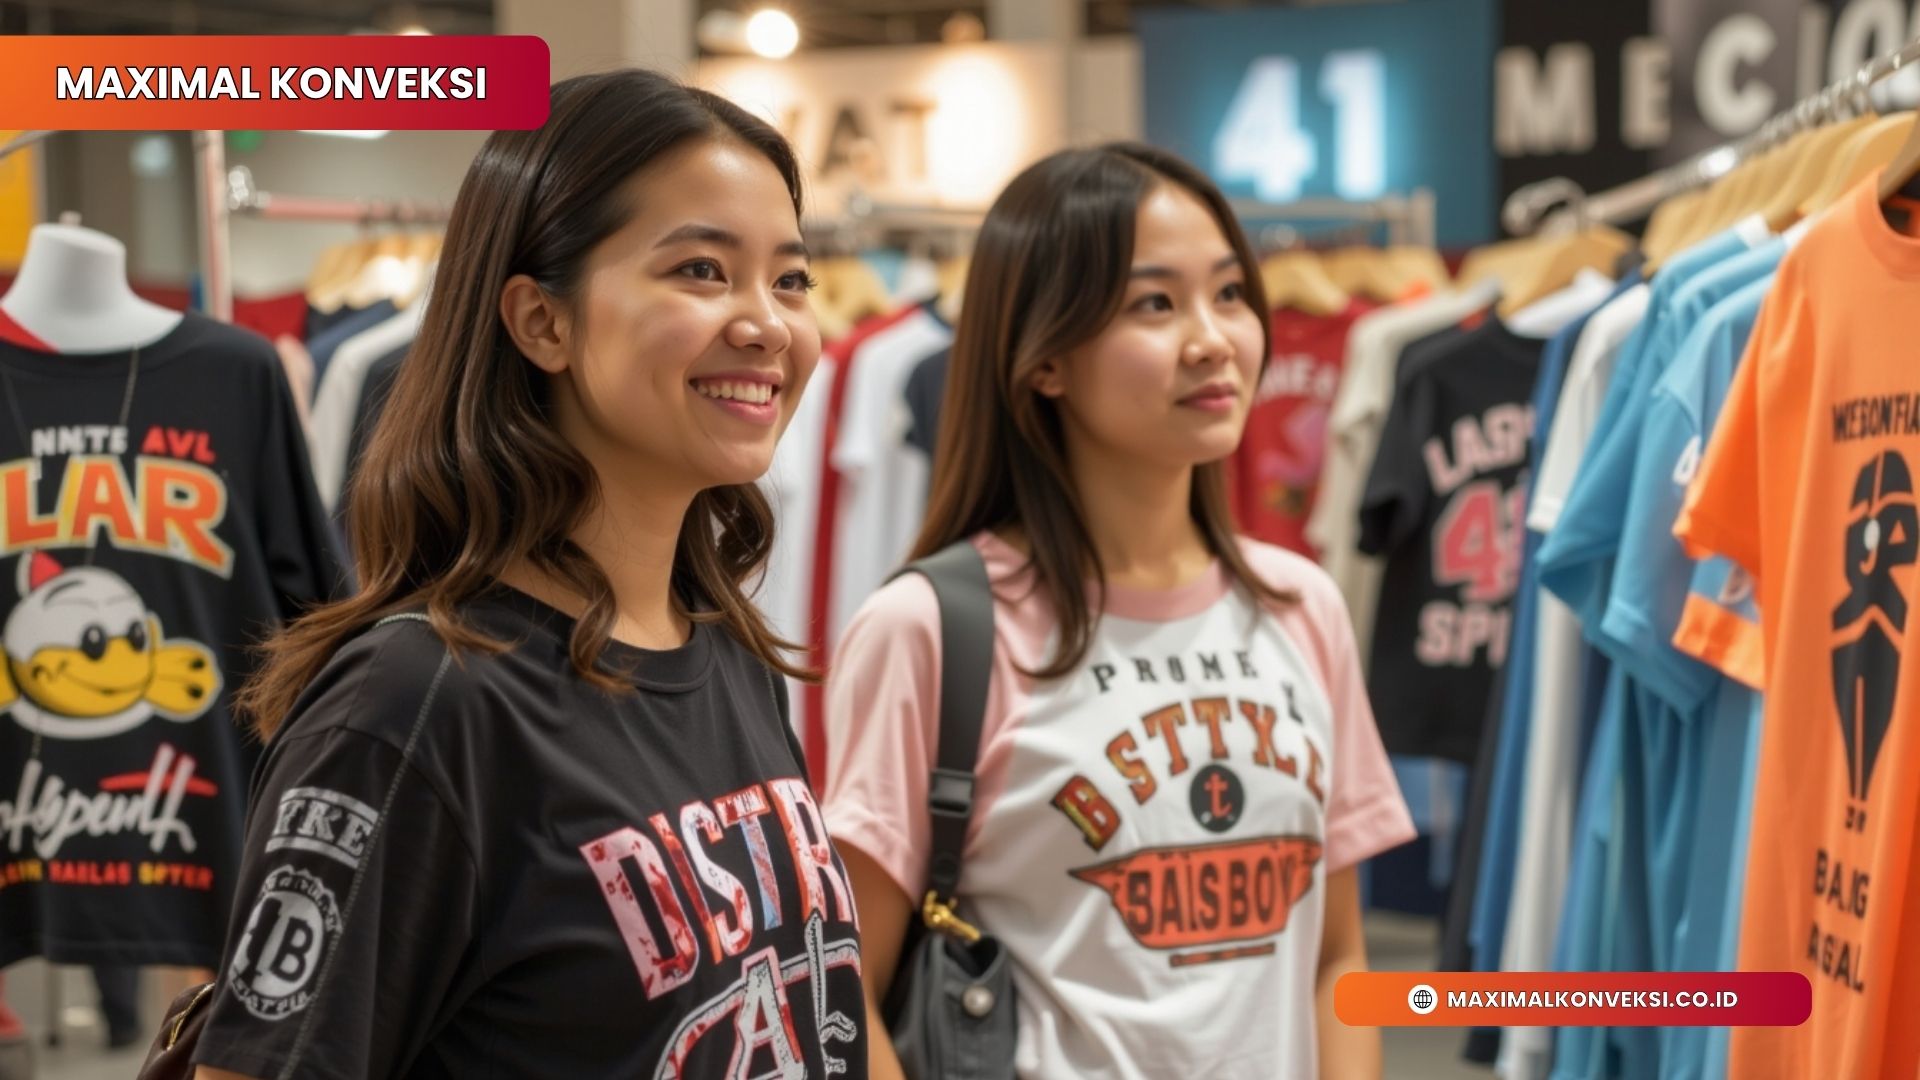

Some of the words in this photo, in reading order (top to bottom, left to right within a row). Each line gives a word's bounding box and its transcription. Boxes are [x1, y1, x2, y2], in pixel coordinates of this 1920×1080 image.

[1213, 48, 1385, 200] 41
[142, 425, 217, 464] AVL
[579, 777, 862, 1001] DISTR
